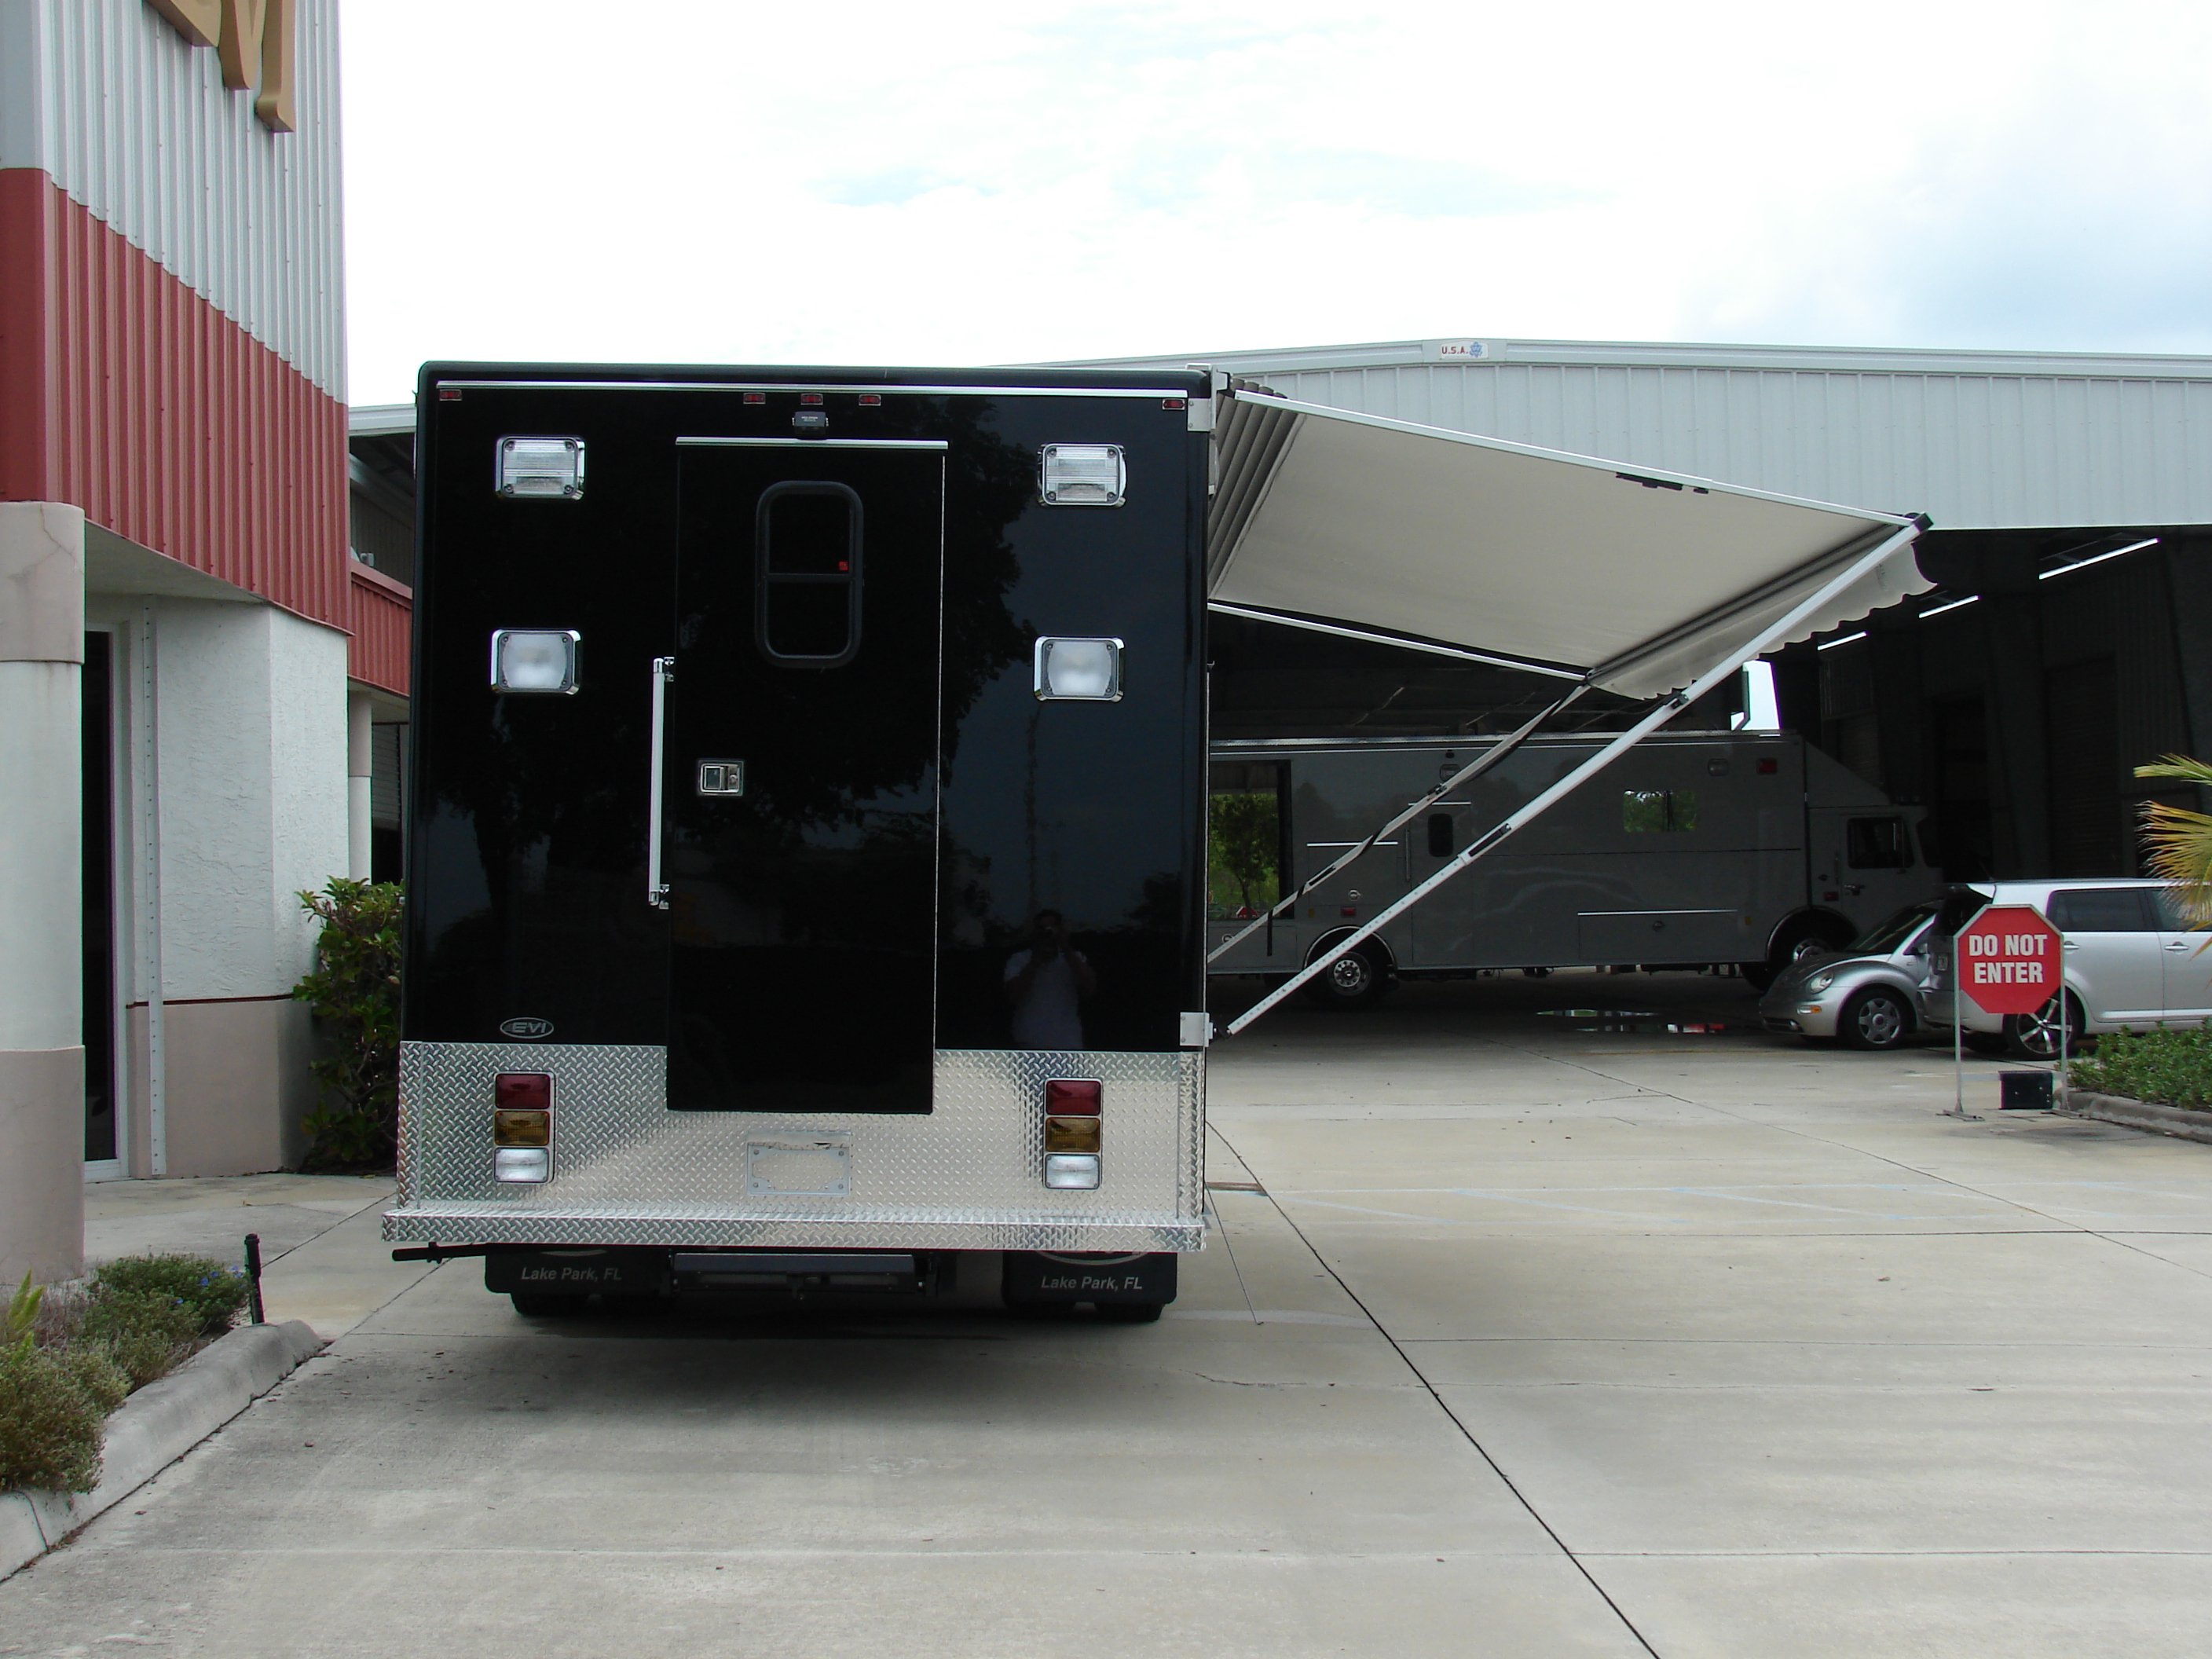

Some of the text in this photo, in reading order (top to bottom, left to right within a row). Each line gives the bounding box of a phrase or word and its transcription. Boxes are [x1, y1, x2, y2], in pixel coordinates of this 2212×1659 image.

[1441, 346, 1468, 354] U.S.A.
[1968, 934, 2047, 956] DO NOT
[1974, 962, 2043, 983] ENTER
[512, 1022, 547, 1033] EVI
[521, 1267, 622, 1282] Lake Park, FL
[1041, 1276, 1142, 1291] Lake Park, FL
